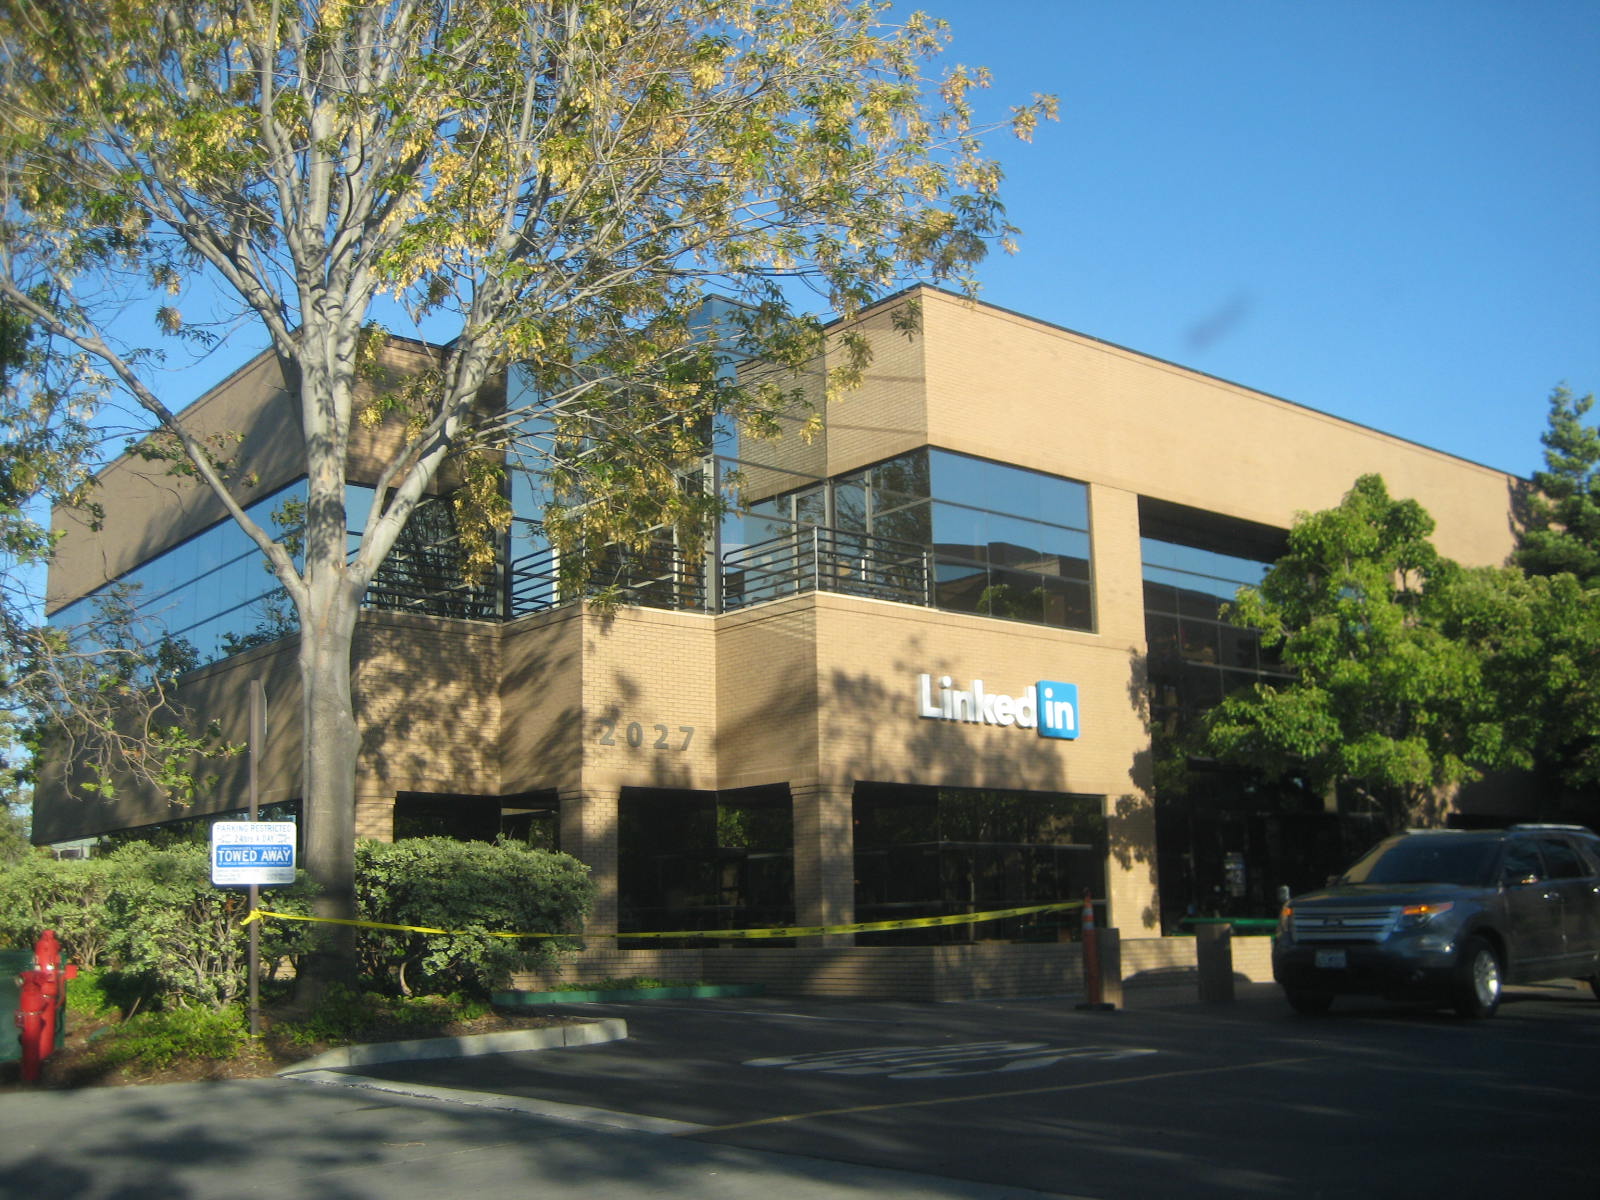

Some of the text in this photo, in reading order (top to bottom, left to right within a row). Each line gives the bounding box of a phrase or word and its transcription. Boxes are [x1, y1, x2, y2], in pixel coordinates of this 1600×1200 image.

[597, 718, 695, 751] 2027
[216, 824, 292, 832] PARKING RESTRICTED
[217, 850, 291, 862] TOWED AWAY
